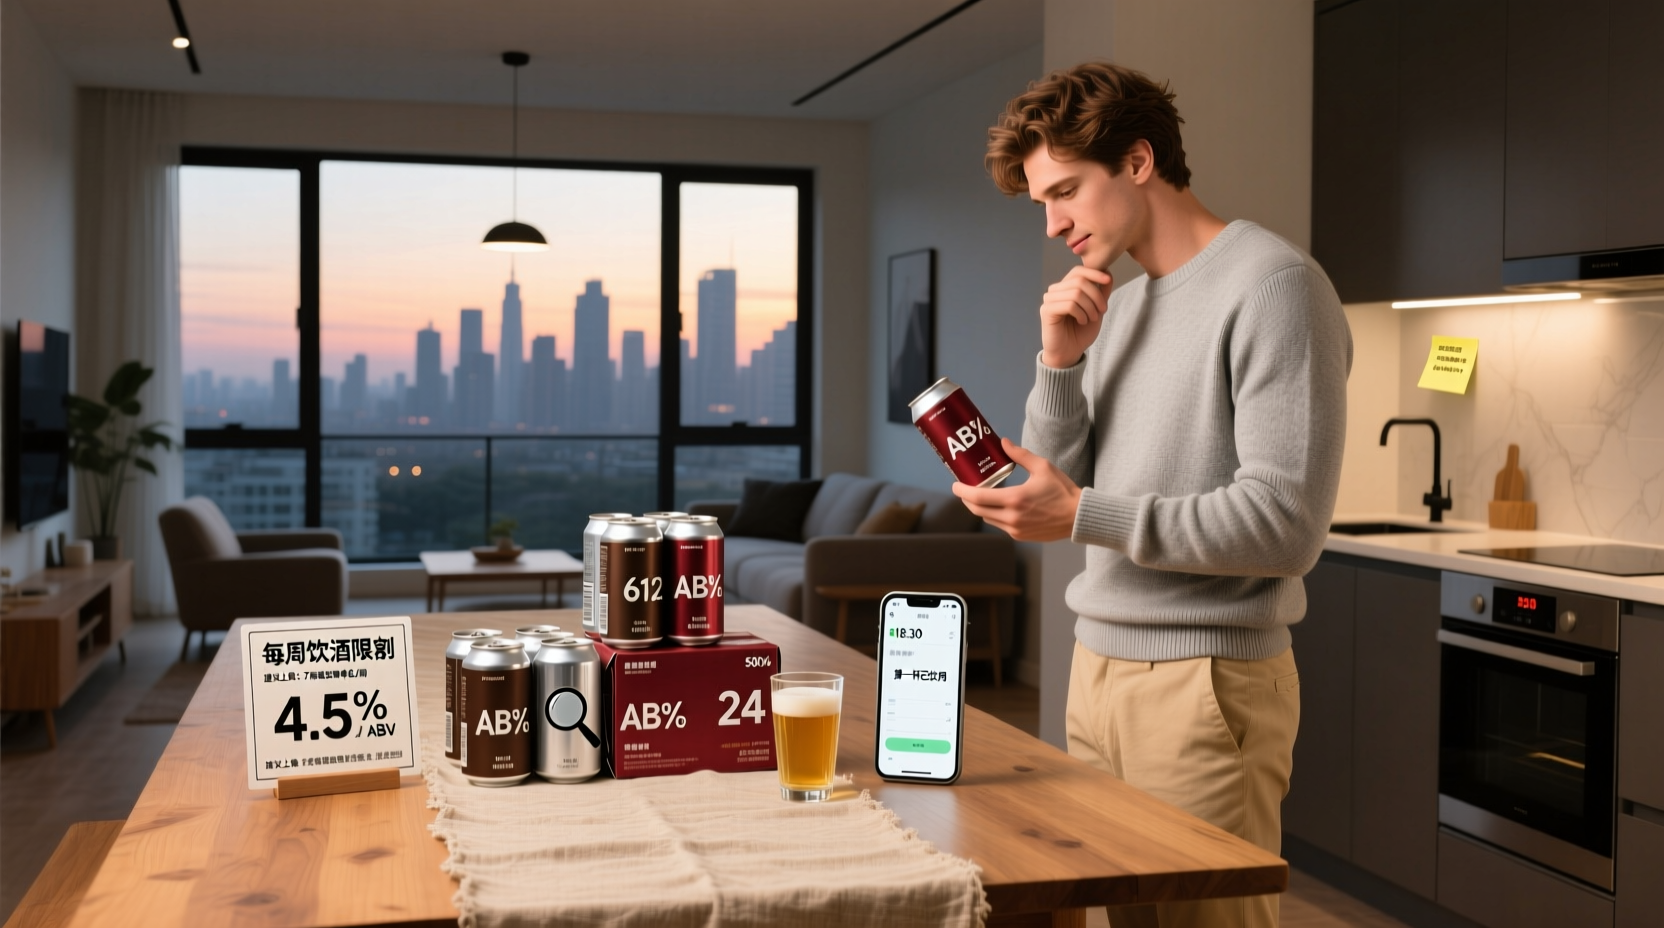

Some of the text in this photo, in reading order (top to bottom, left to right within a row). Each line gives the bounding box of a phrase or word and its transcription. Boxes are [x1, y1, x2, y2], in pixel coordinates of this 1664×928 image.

[947, 416, 991, 461] AB%
[624, 576, 663, 602] 612
[674, 574, 723, 599] AB%
[274, 690, 387, 740] 4.5%
[475, 707, 529, 737] AB%
[620, 700, 688, 732] AB%
[718, 690, 767, 727] 24
[367, 723, 396, 738] ABV
